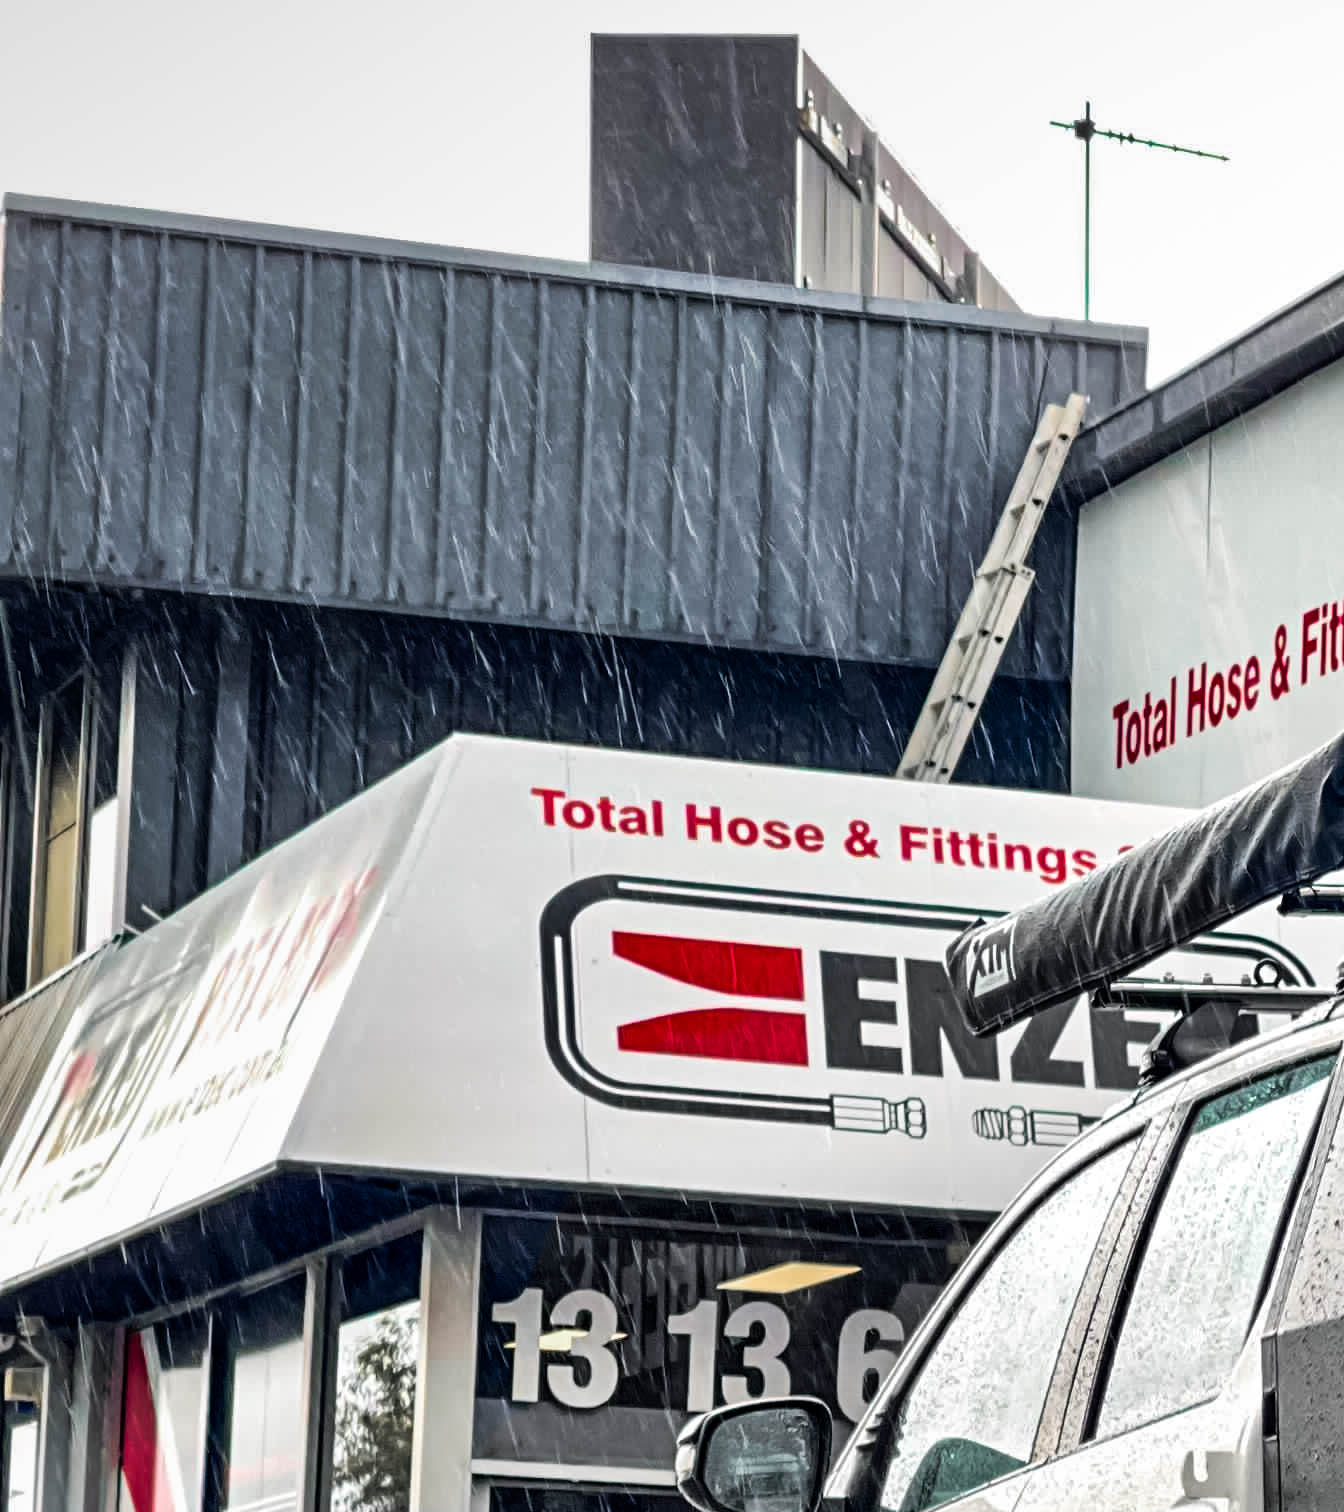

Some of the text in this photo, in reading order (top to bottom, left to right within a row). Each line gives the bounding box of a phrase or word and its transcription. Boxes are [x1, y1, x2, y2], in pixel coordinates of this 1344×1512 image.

[1112, 676, 1177, 769] Total
[1186, 655, 1260, 737] Hose
[1270, 624, 1290, 700] &
[532, 787, 1099, 884] Total Hose & Fittings
[820, 950, 1259, 1090] ENZE
[492, 1288, 618, 1409] 13
[668, 1301, 792, 1412] 13
